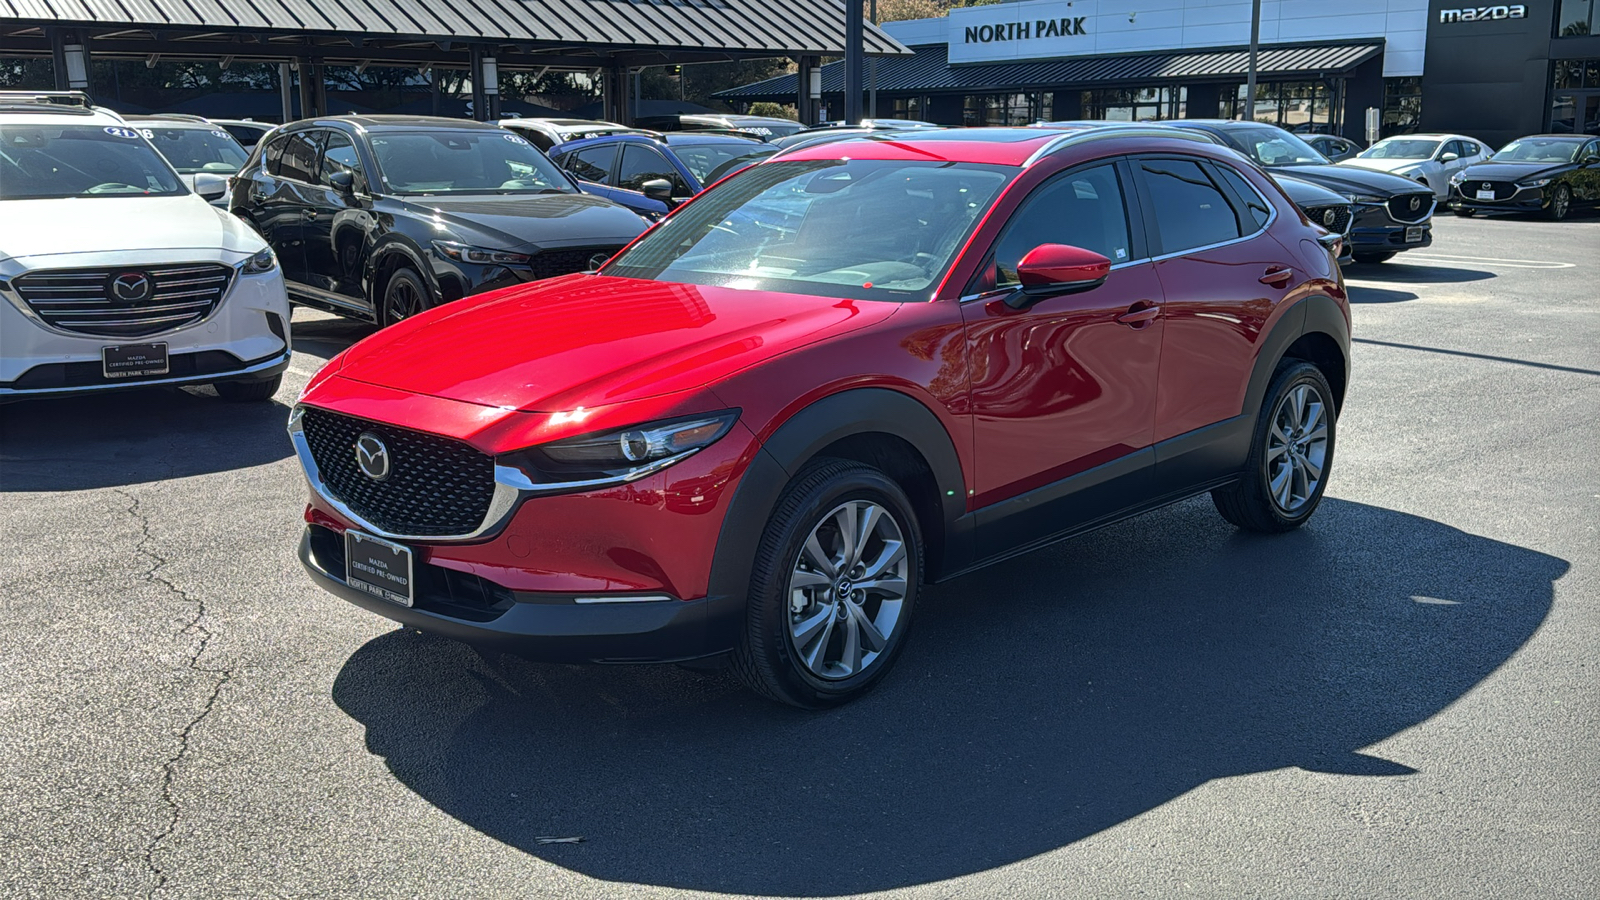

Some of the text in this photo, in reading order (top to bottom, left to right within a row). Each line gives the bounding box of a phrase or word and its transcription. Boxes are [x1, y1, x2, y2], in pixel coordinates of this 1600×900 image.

[965, 16, 1086, 43] NORTH PARK
[352, 560, 408, 586] CERTIFIED PRE-OWNED
[368, 557, 389, 570] MAZDA
[349, 578, 368, 591] NORTH
[368, 585, 384, 598] PARK
